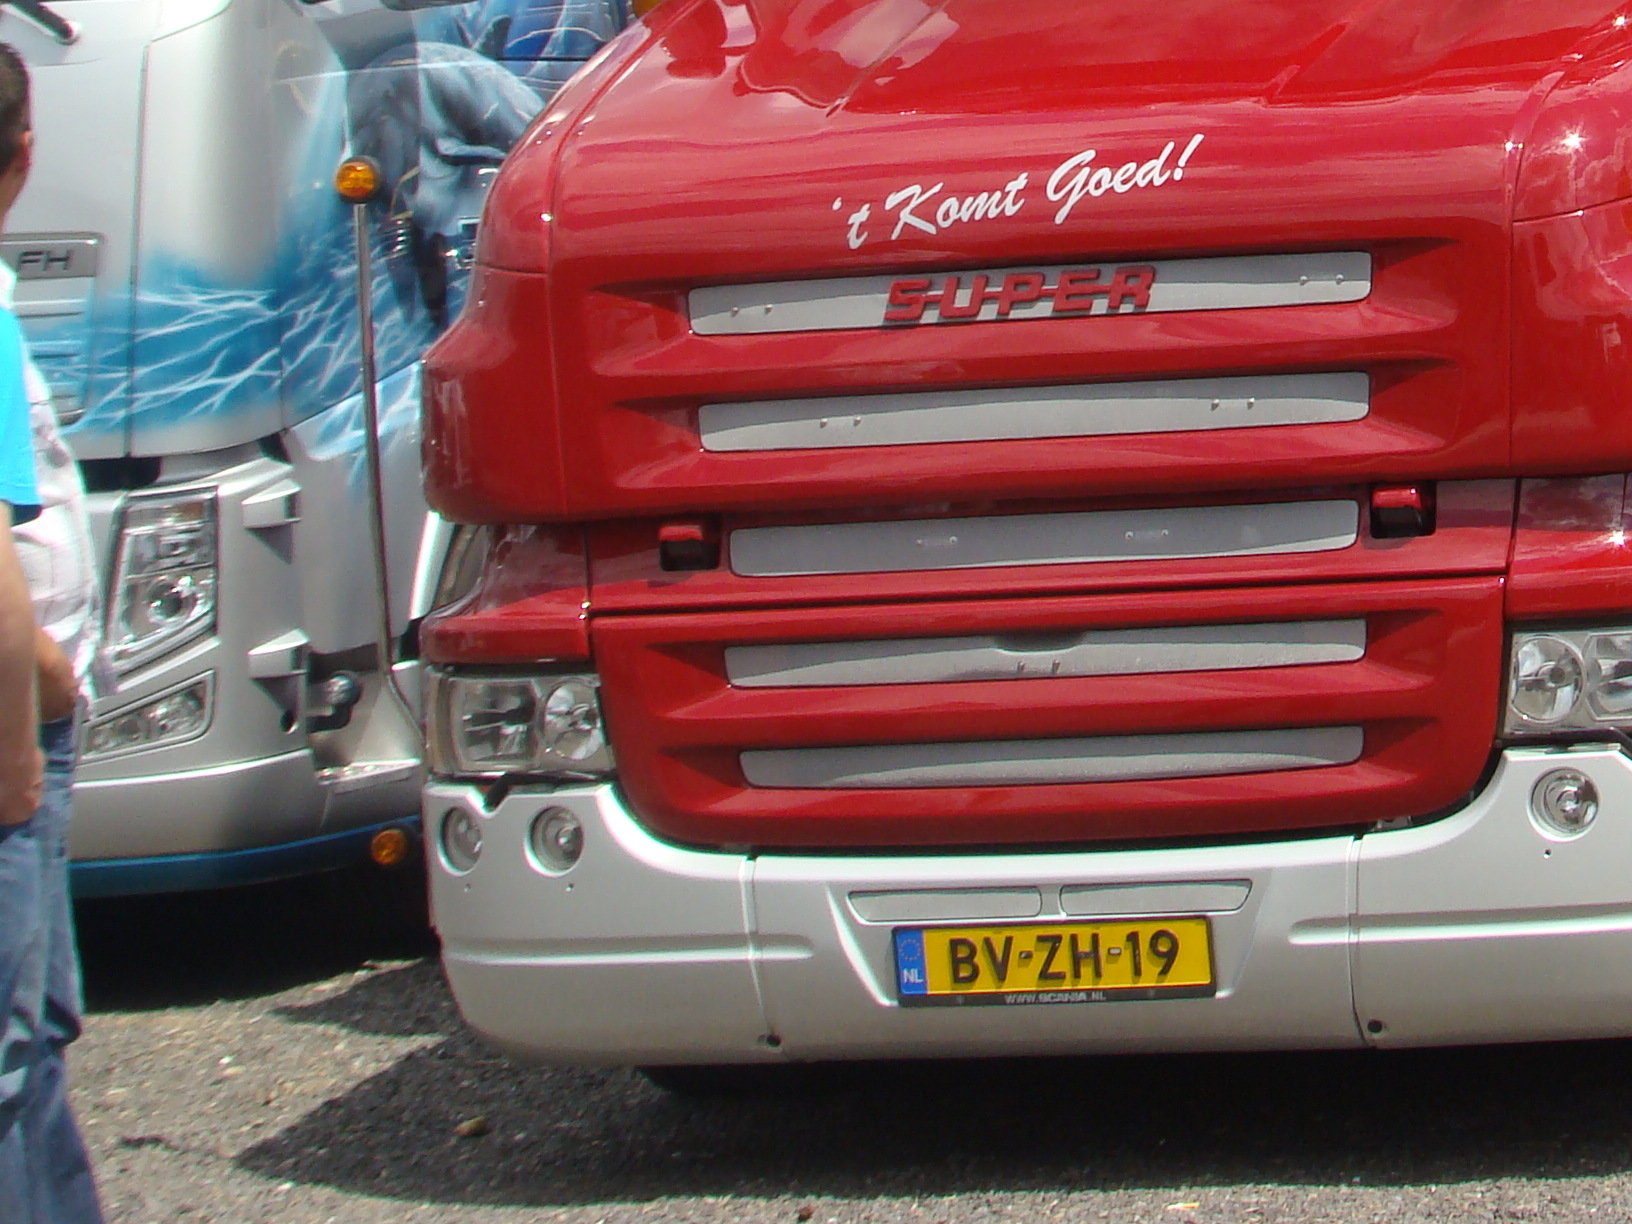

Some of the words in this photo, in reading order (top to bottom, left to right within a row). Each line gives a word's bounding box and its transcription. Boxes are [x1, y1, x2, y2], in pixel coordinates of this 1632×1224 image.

[884, 171, 1028, 240] Komt
[1046, 133, 1205, 225] Goed!
[16, 249, 74, 272] FH
[885, 266, 1156, 323] SUPER
[903, 968, 924, 984] NL
[948, 928, 1181, 985] BV-ZH-19
